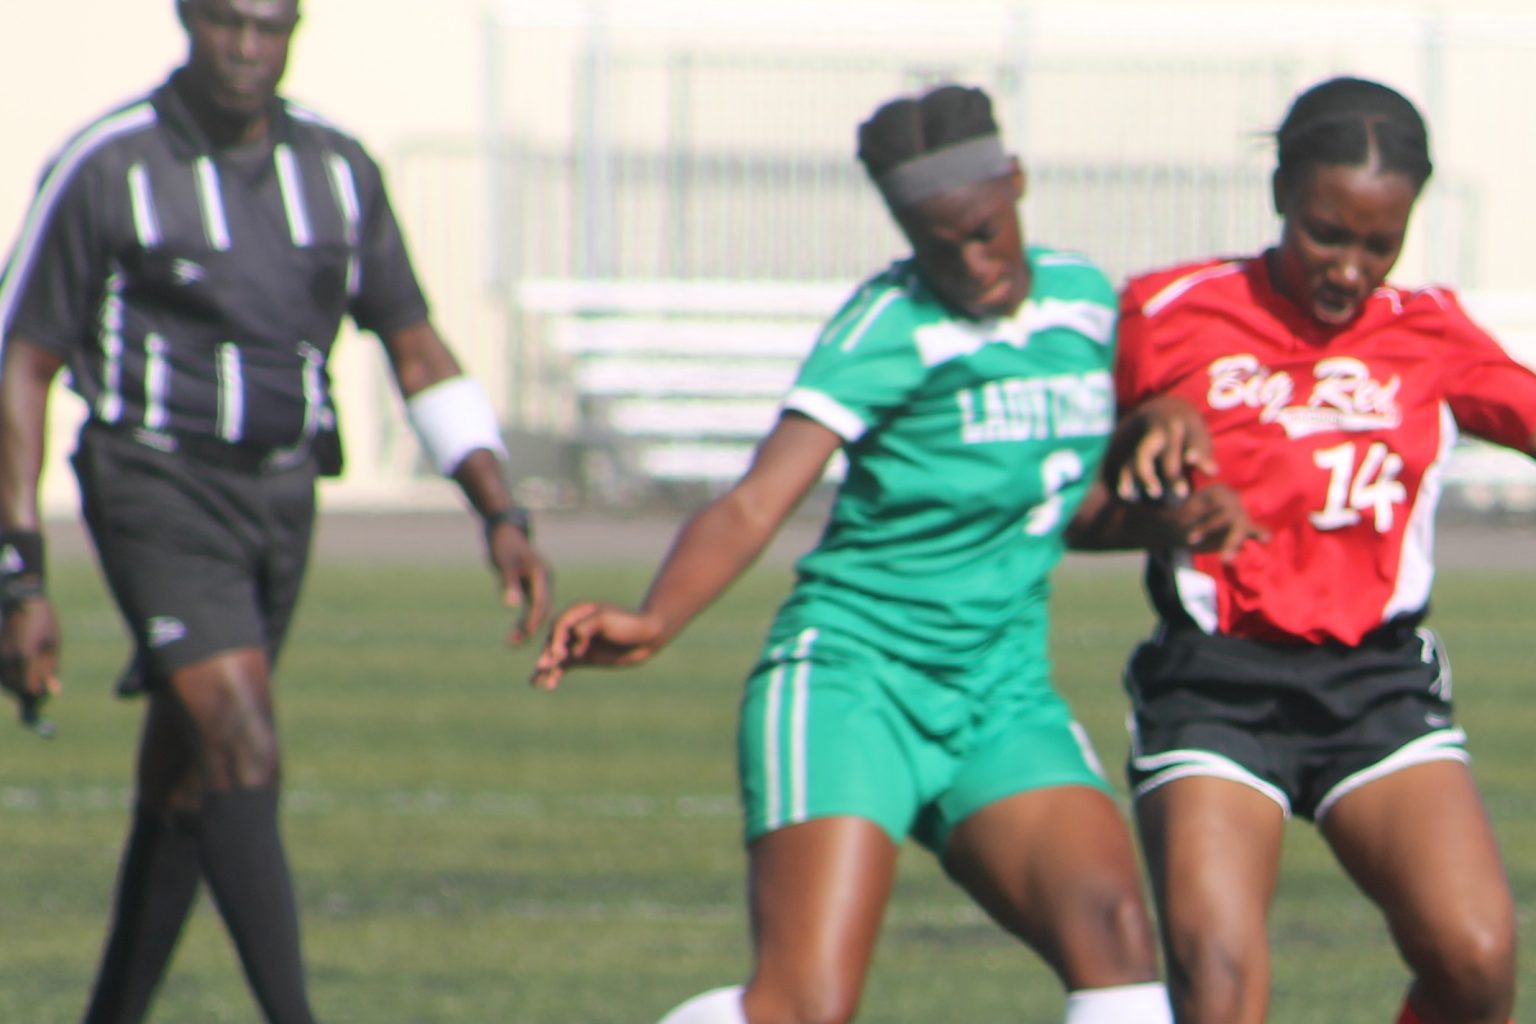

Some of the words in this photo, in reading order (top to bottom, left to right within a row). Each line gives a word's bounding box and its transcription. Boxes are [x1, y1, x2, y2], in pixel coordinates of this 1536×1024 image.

[1206, 353, 1294, 424] Big
[1307, 356, 1402, 414] Red
[1309, 442, 1407, 533] 14
